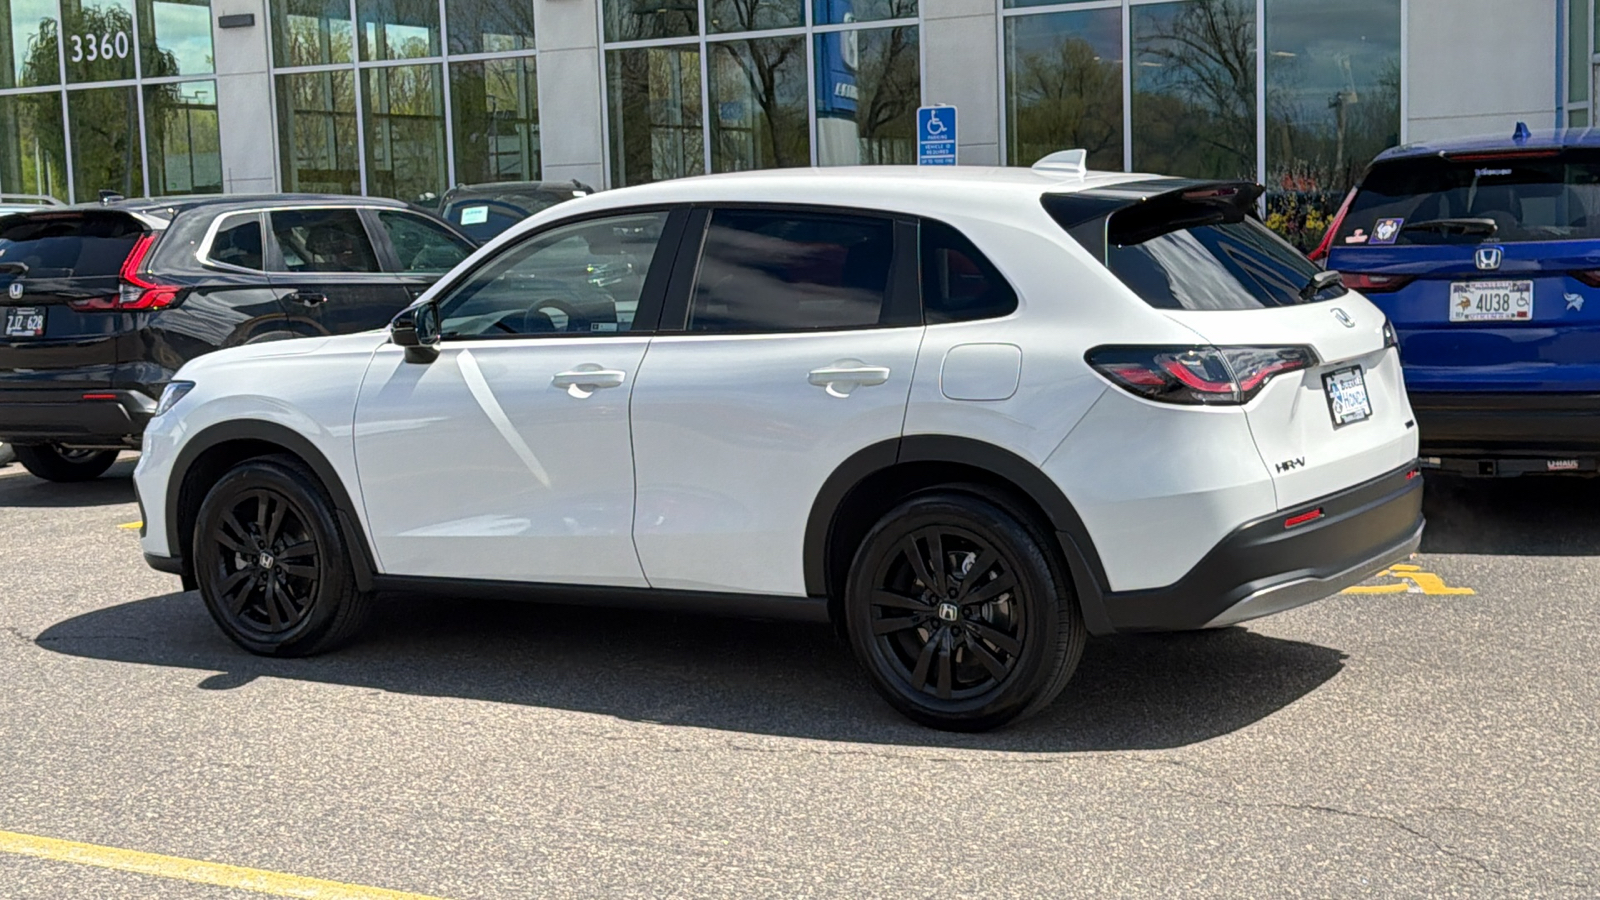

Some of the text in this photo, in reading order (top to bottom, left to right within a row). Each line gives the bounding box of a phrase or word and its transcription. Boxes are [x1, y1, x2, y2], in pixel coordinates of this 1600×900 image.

[71, 31, 129, 63] 3360
[1476, 293, 1510, 312] 4U38
[1342, 391, 1367, 408] HONDA
[1275, 456, 1305, 474] HR-V
